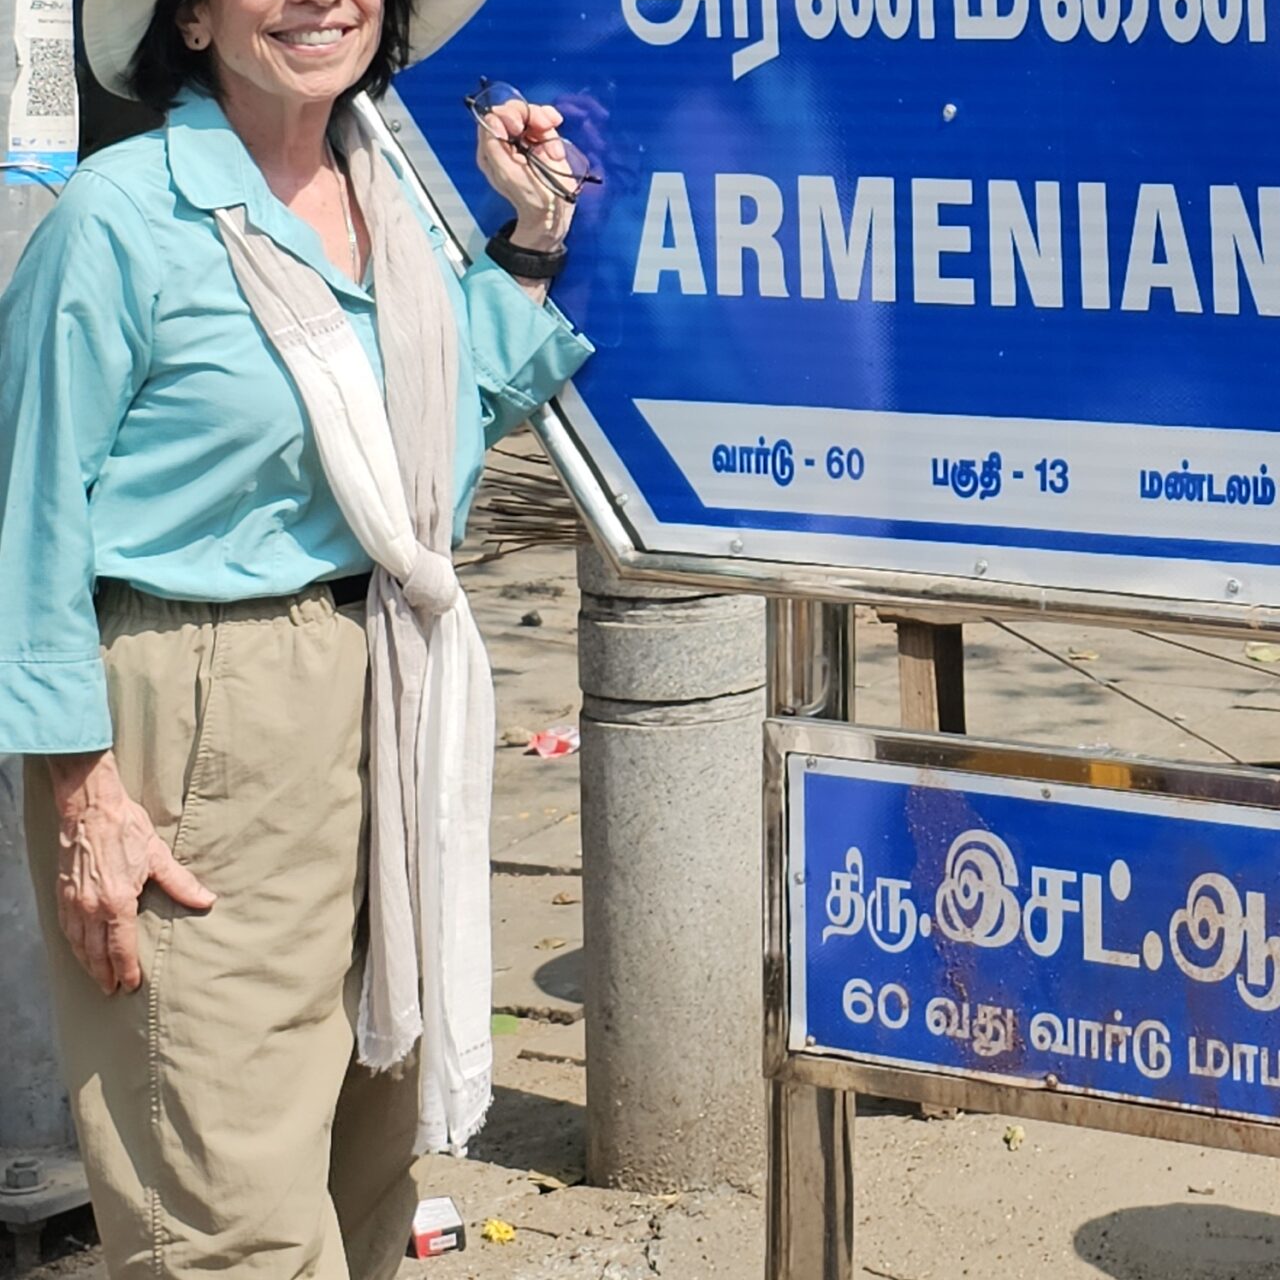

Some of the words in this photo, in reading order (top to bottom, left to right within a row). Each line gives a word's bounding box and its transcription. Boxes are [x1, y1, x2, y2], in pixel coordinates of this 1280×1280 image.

[713, 437, 794, 486] வார்டு
[827, 447, 865, 480] 60
[932, 452, 1001, 500] பகுதி
[1035, 459, 1069, 493] 13
[1141, 460, 1275, 505] மண்டலம்
[842, 978, 910, 1029] 60
[926, 998, 1014, 1056] வது
[1030, 1010, 1171, 1080] வார்டு
